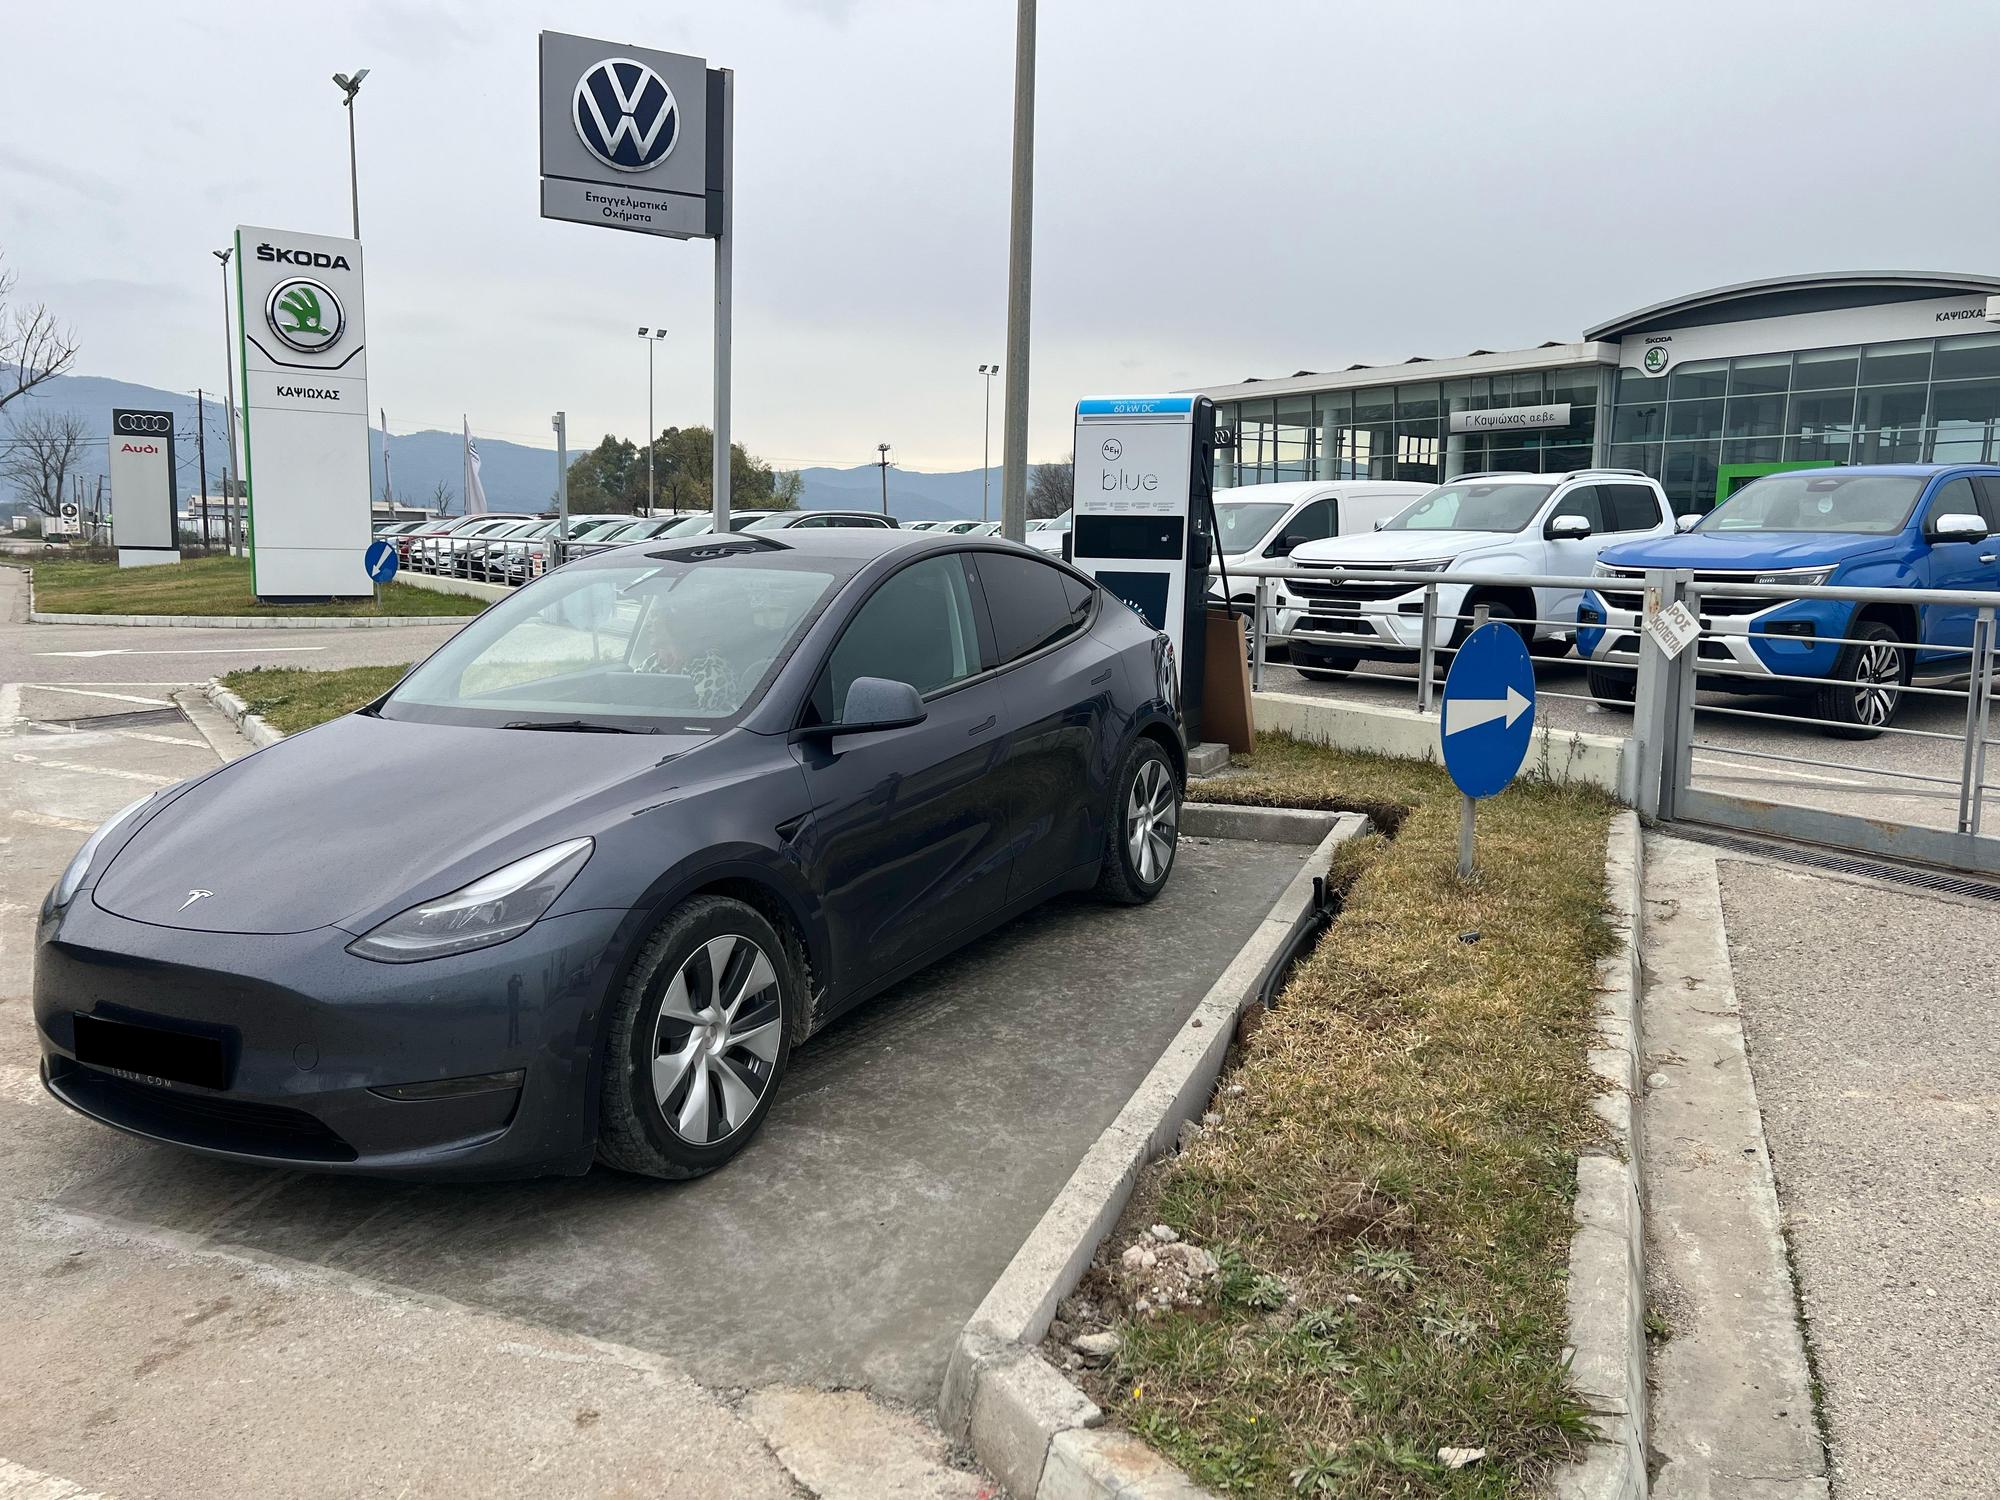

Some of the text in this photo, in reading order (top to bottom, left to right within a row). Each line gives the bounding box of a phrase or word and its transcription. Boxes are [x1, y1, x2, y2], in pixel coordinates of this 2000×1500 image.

[585, 191, 668, 211] Επαγγελματικά
[602, 206, 652, 222] Οχήματα
[256, 243, 351, 271] ŠKODA
[276, 386, 340, 401] ΚΑΨΙΩΧΑΣ
[1113, 404, 1155, 413] 60 kW DC
[1474, 413, 1526, 427] Καψιώχας
[1529, 411, 1555, 422] αεβε
[121, 443, 159, 454] Audi
[1104, 444, 1120, 455] ΔΕΗ
[1102, 468, 1159, 491] blue
